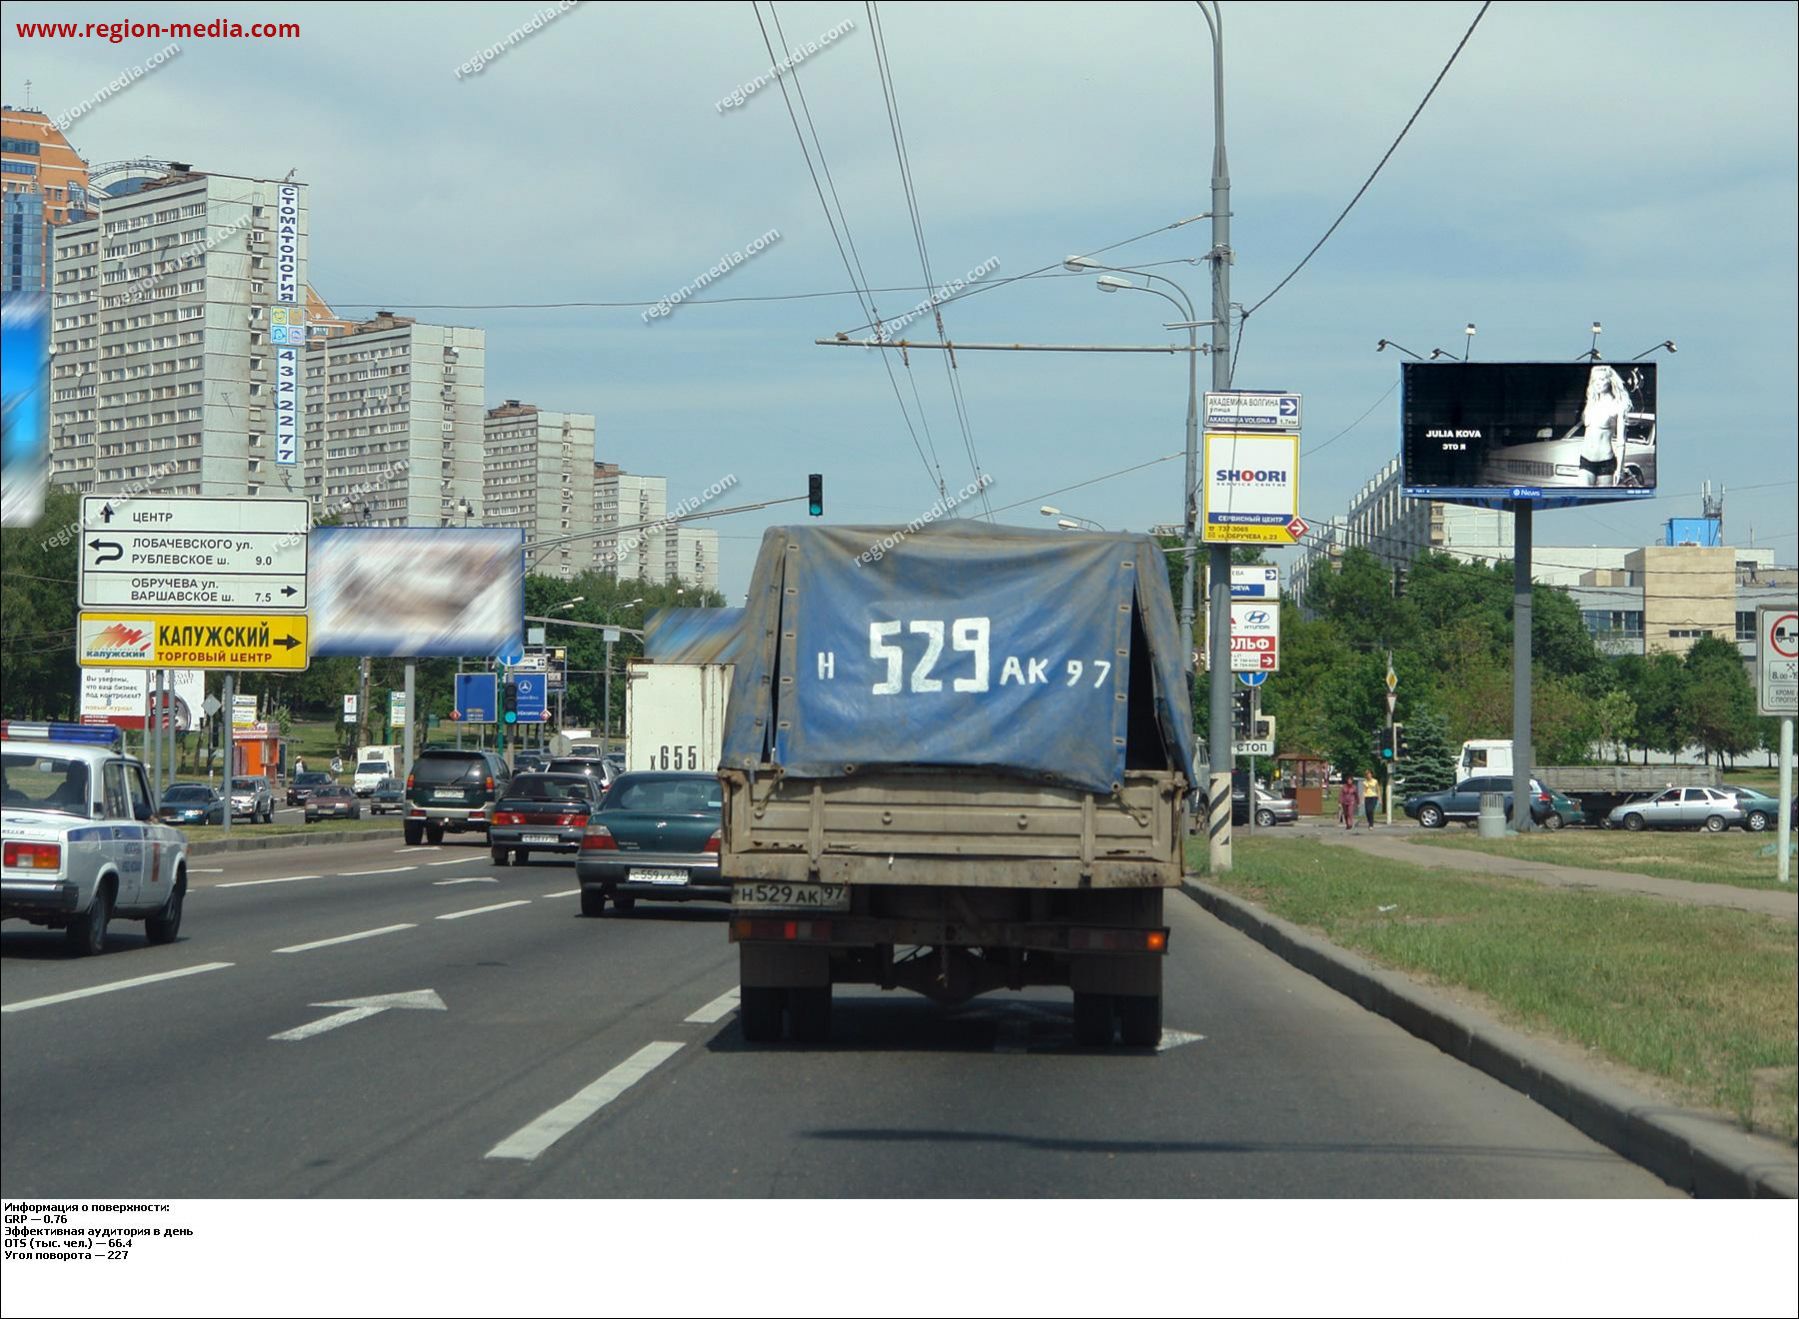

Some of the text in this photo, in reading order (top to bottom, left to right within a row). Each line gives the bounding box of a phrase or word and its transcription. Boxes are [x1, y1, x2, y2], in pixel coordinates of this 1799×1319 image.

[281, 187, 296, 302] СТОМАТОЛОГИЯ
[1209, 397, 1279, 406] АКАДЕМИКА ВОЛГИНА
[1425, 430, 1482, 438] JULIA KOVA
[1216, 469, 1287, 482] SHOORI
[132, 513, 173, 523] ЦЕНТР
[1218, 515, 1260, 523] СЕРВИСНЫЙ
[132, 538, 253, 551] ЛОБАЧЕВСКОГО ул.
[132, 555, 213, 565] РУБЛЕВСКОЕ
[255, 556, 272, 566] 9.0
[131, 578, 219, 590] ОБРУЧЕВА ул.
[131, 591, 272, 602] ВАРШАВСКОЕ ш. 7.5
[159, 622, 270, 648] КАЛУЖСКИЙ
[86, 649, 146, 659] калужский
[157, 650, 272, 664] ТОРГОВЫЙ ЦЕНТР
[817, 617, 1111, 695] Н 529 АК 97
[1237, 742, 1267, 752] СТОП
